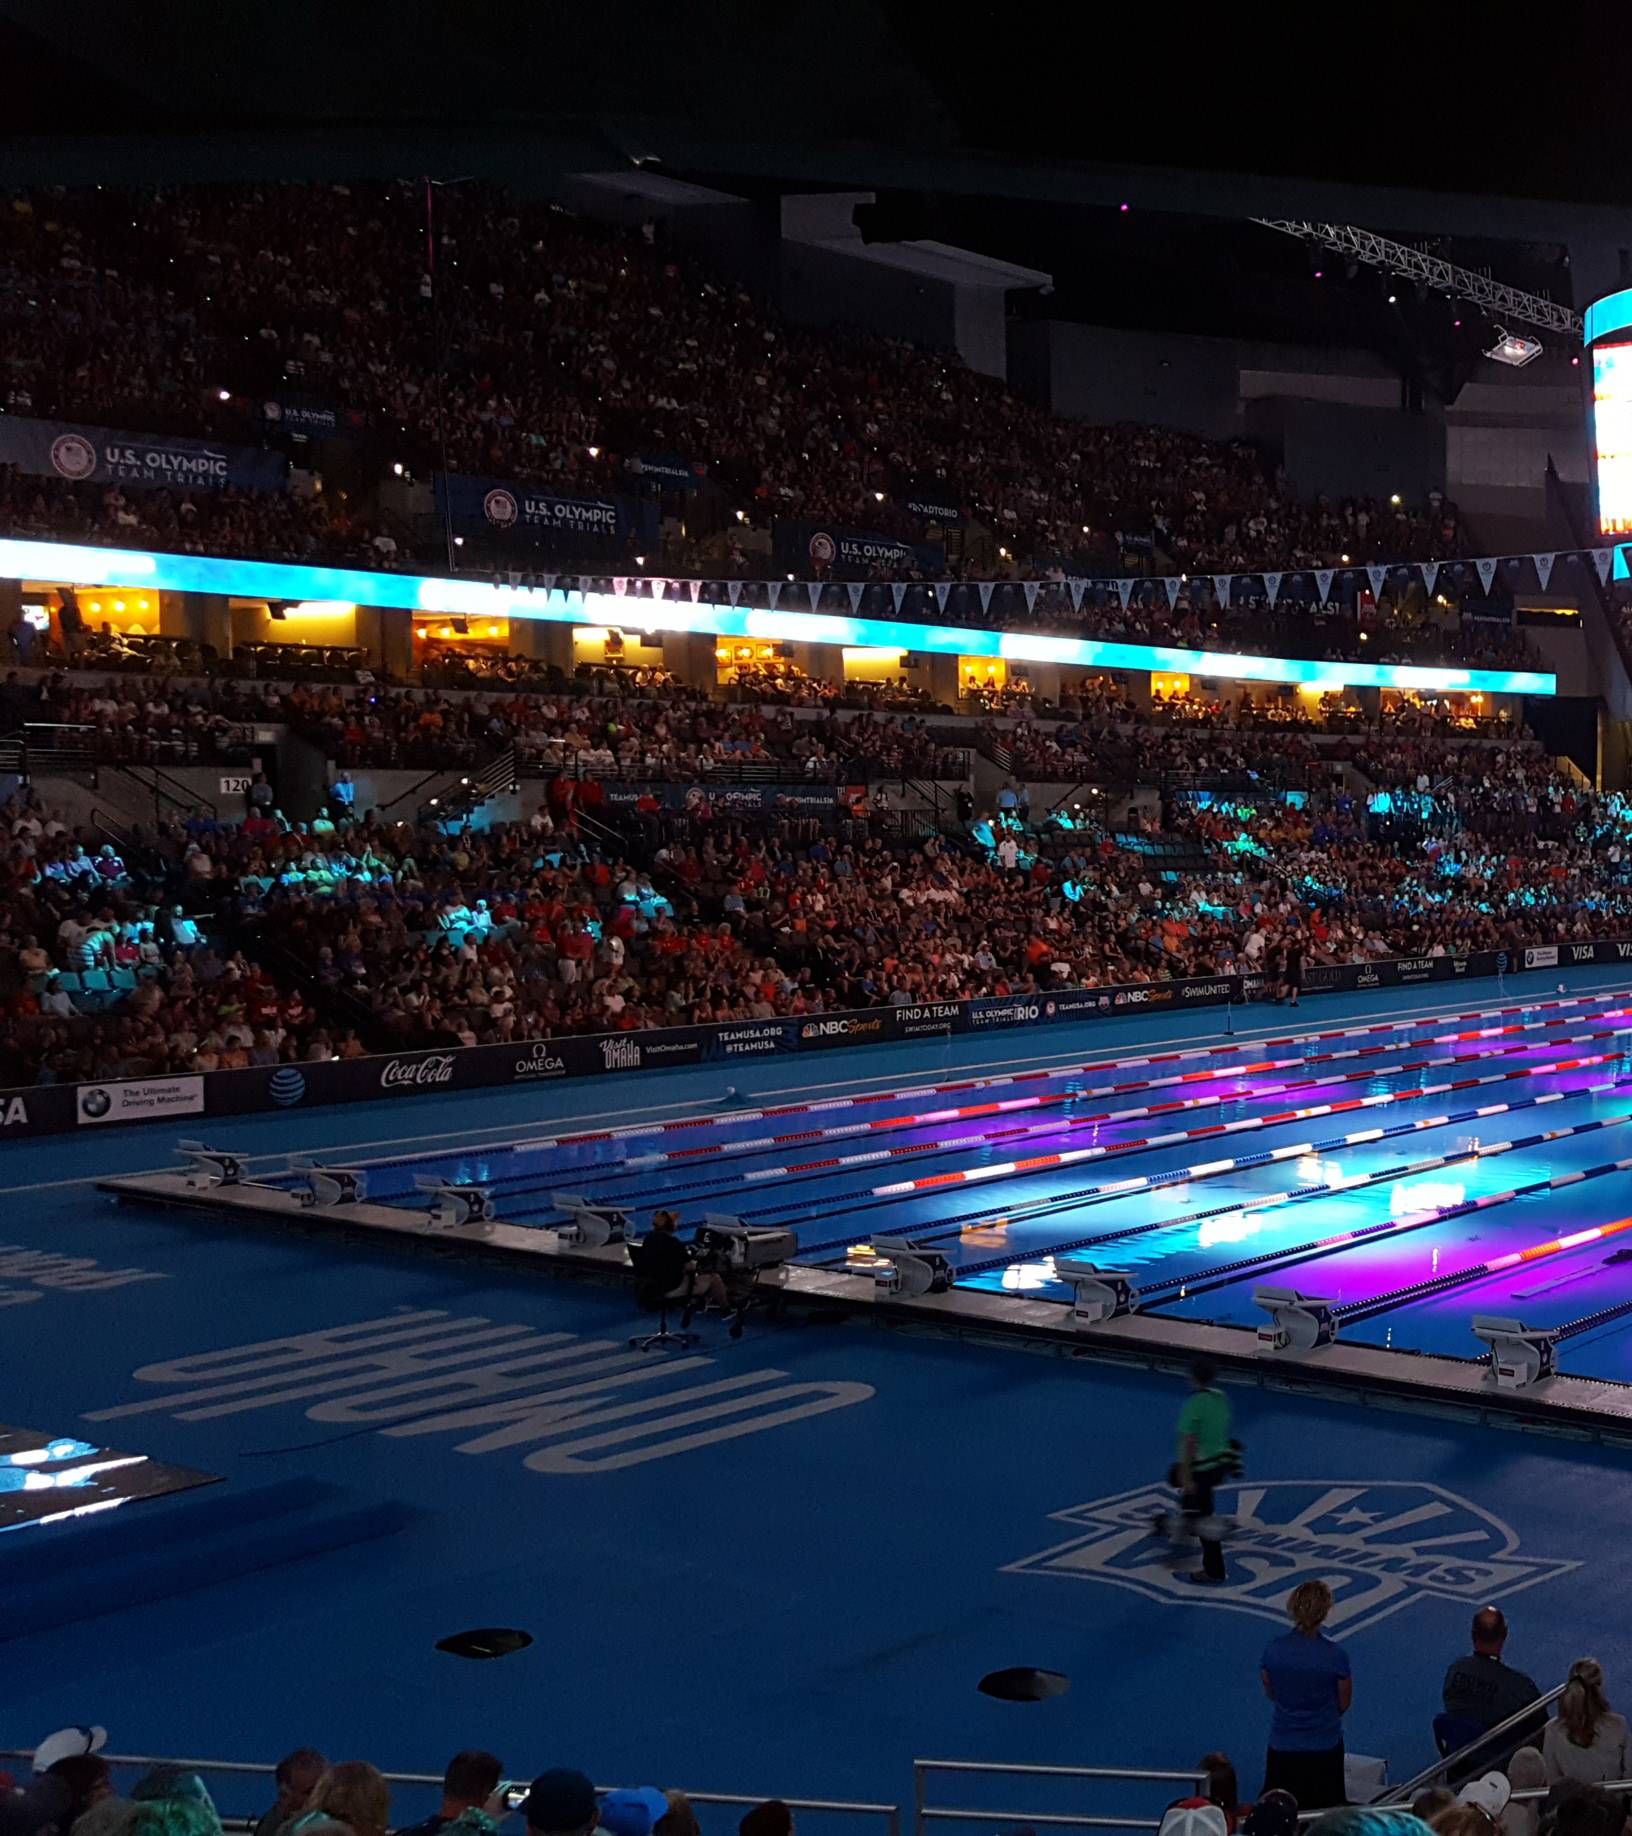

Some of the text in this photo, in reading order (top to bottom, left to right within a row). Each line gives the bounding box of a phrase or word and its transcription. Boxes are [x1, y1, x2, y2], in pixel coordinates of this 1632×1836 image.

[106, 447, 227, 476] U.S. OLYMPIC
[106, 464, 227, 488] TEAM TRIALS
[525, 499, 616, 523] U.S. OLYMPIC
[525, 514, 616, 534] TEAM TRIALS
[840, 541, 907, 560] U.S. OLYMPI
[224, 779, 249, 792] 120
[1571, 945, 1595, 961] VISA
[1418, 960, 1434, 969] TEAM
[1357, 974, 1380, 984] OMEGA
[1127, 990, 1148, 1002] NBC
[896, 1005, 959, 1022] FIND A TEAM
[986, 1008, 1014, 1018] OLYMPIC
[1018, 1005, 1039, 1020] RIO
[718, 1027, 783, 1041] TEAMUSA.ORG
[820, 1020, 848, 1035] NBC
[599, 1037, 627, 1053] Visit
[726, 1041, 775, 1053] @TEAMUSA
[515, 1057, 564, 1073] OMEGA
[123, 1087, 180, 1097] The Ultimate
[122, 1098, 154, 1107] Driving
[82, 1309, 876, 1474] OMAHA
[1117, 1503, 1493, 1587] SWIMMG
